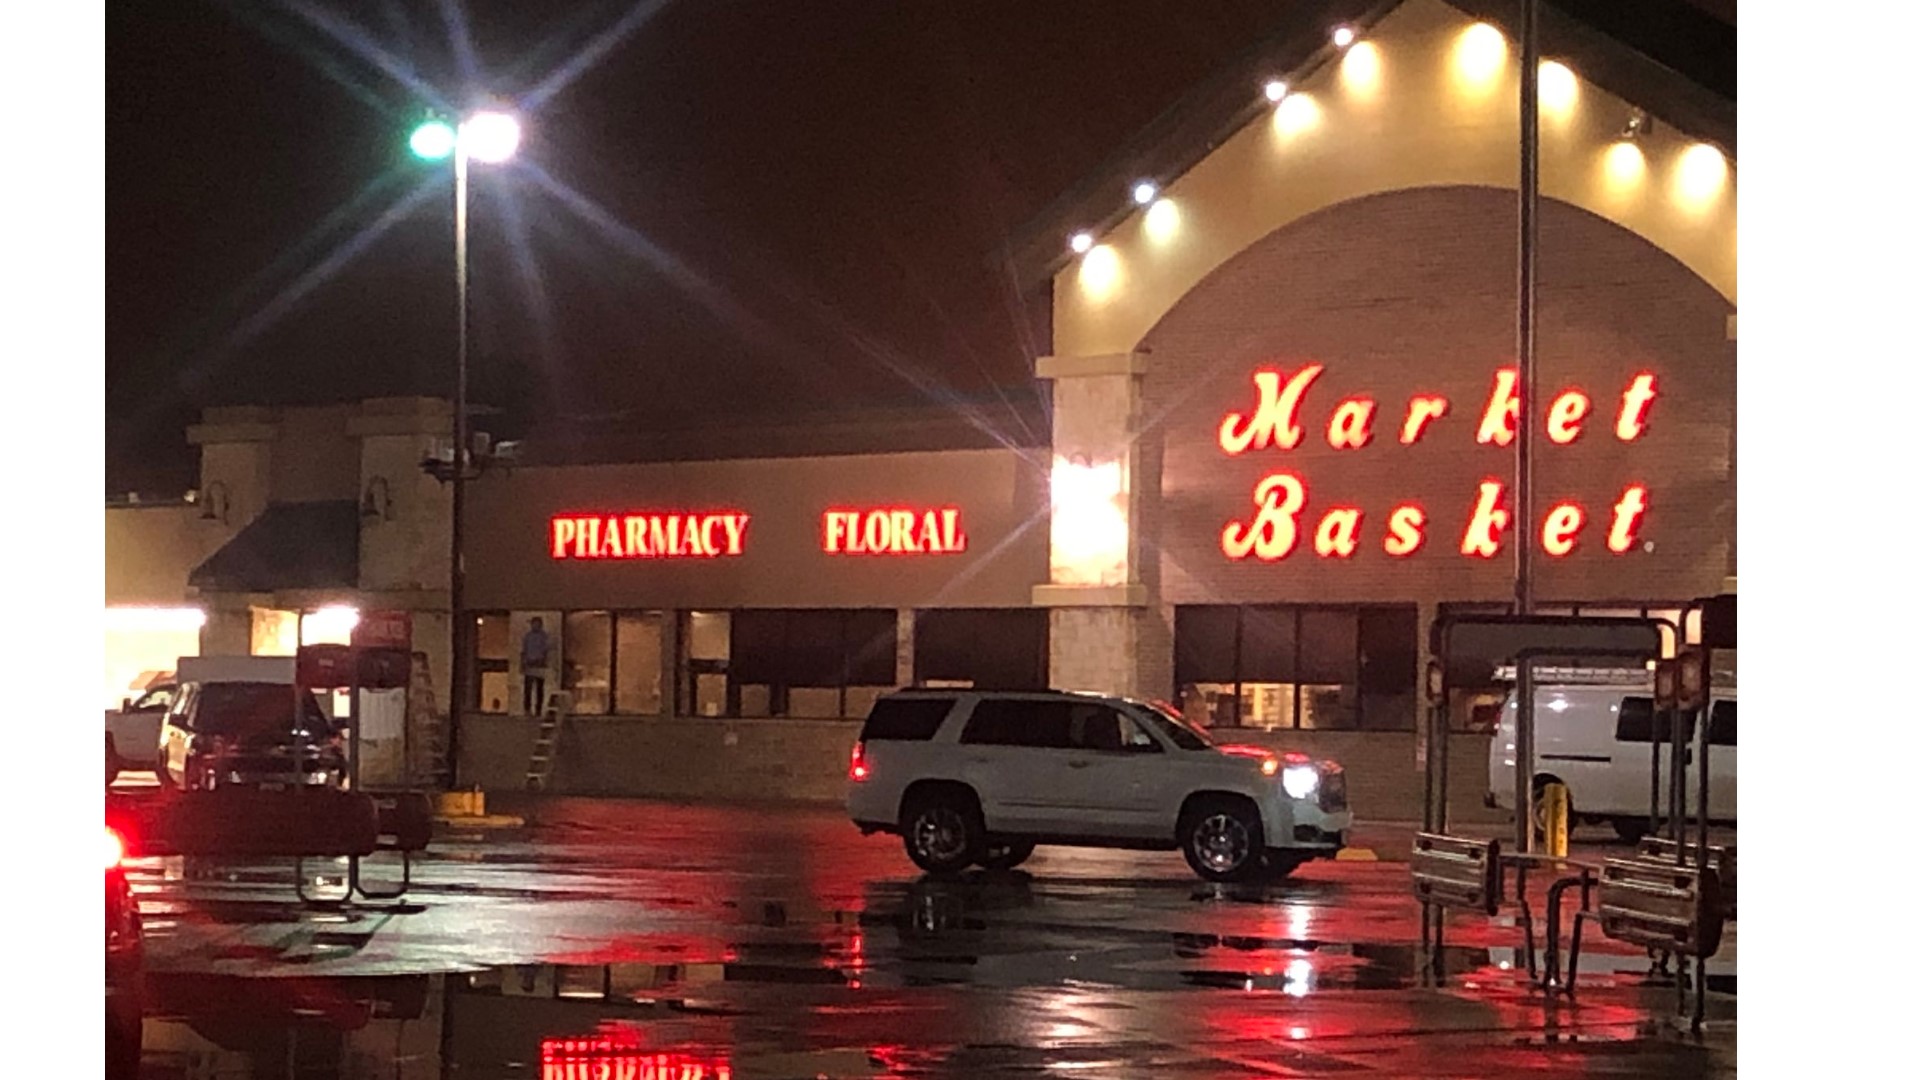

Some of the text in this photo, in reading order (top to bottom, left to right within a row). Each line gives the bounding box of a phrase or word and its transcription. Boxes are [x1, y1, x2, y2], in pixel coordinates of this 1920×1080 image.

[1217, 363, 1658, 455] Market
[551, 513, 748, 558] PHARMACY
[822, 508, 967, 555] FLORAL
[1220, 473, 1647, 560] Basket
